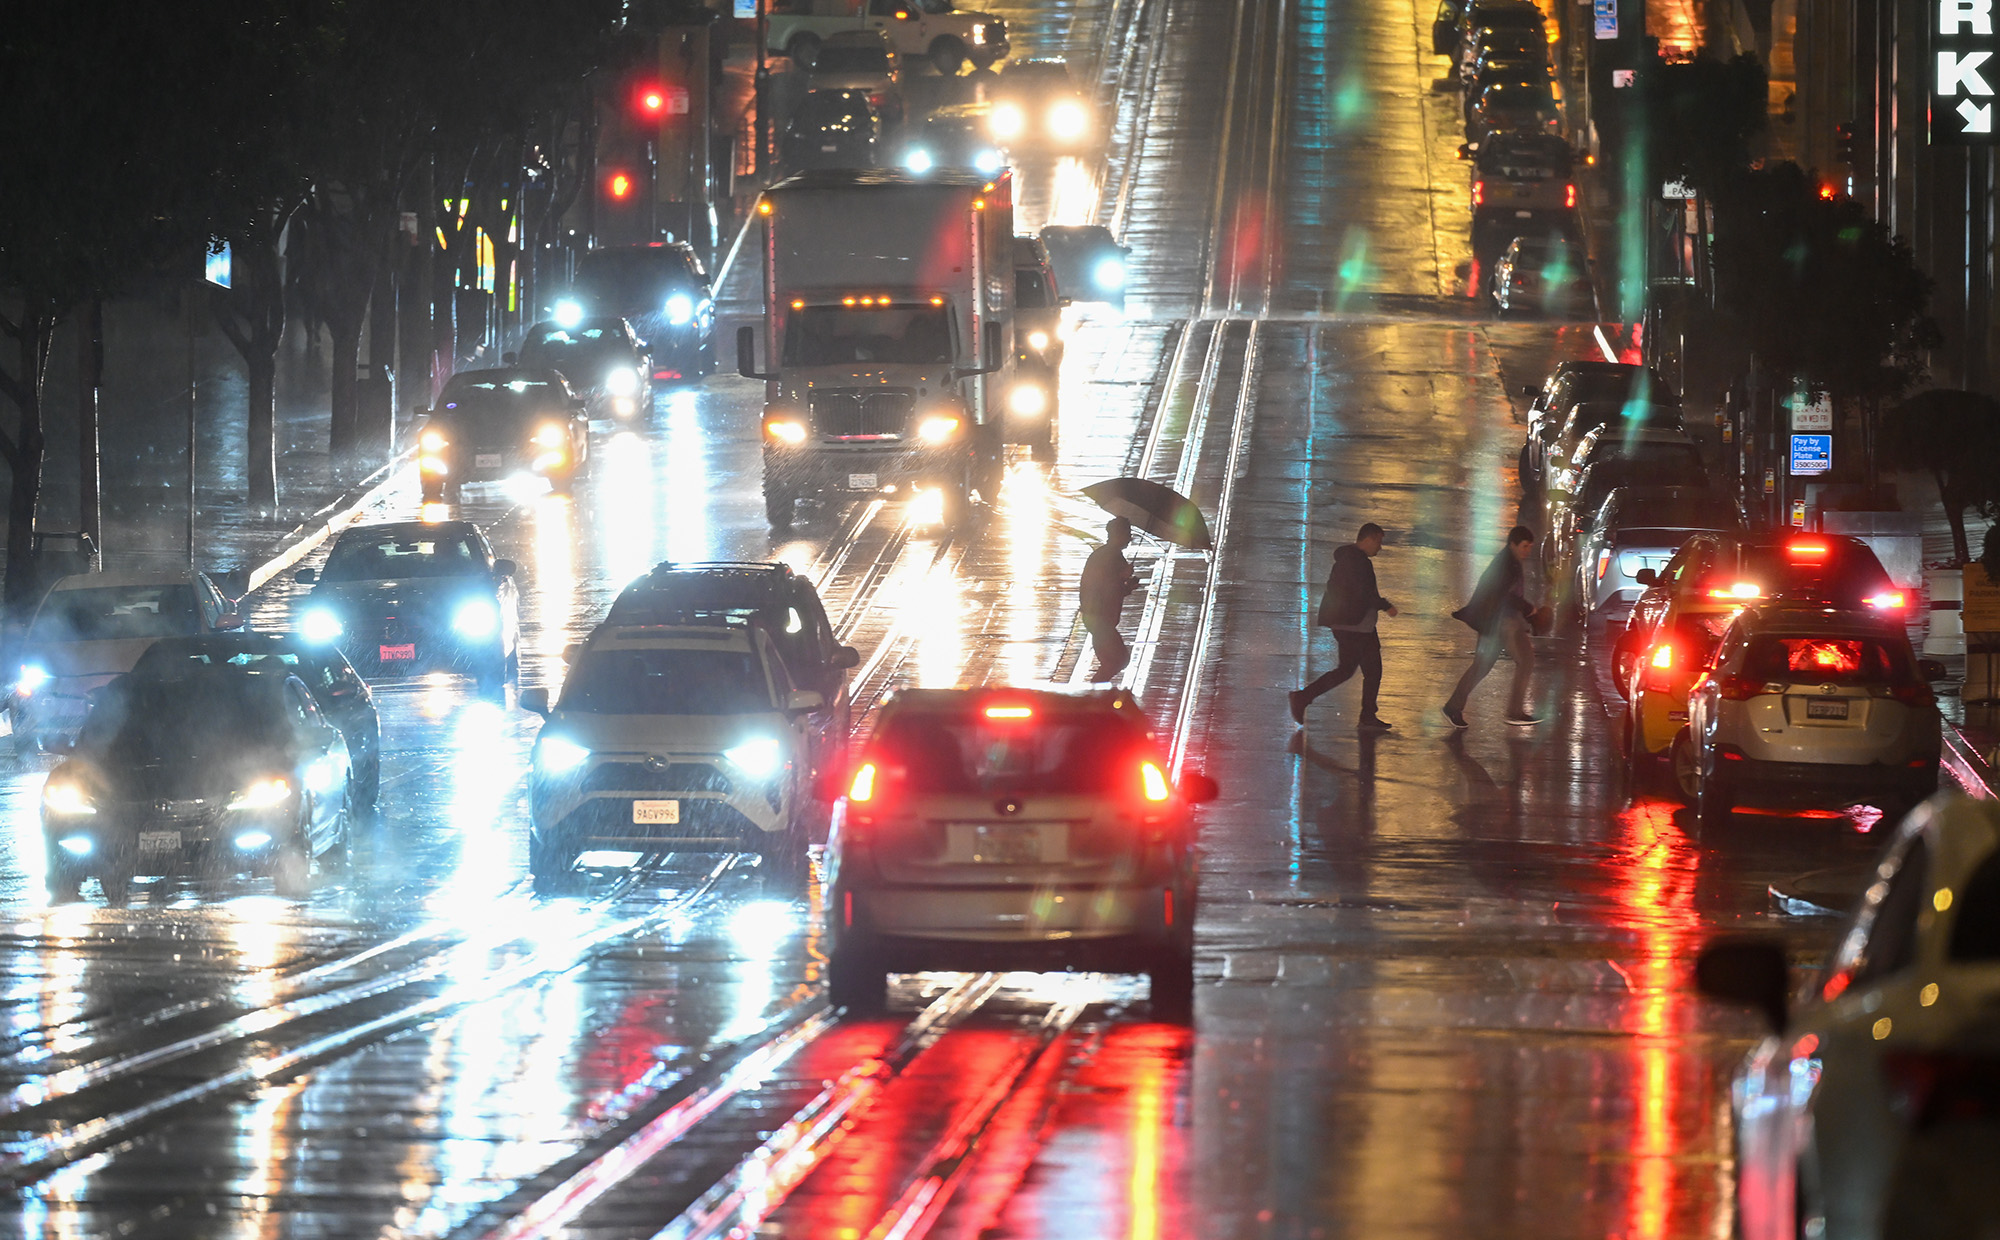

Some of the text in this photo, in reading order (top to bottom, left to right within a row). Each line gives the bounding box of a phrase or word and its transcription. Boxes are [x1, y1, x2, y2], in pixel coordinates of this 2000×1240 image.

[1809, 414, 1819, 423] WED
[1820, 414, 1829, 423] FRI
[1794, 438, 1820, 446] Pay by
